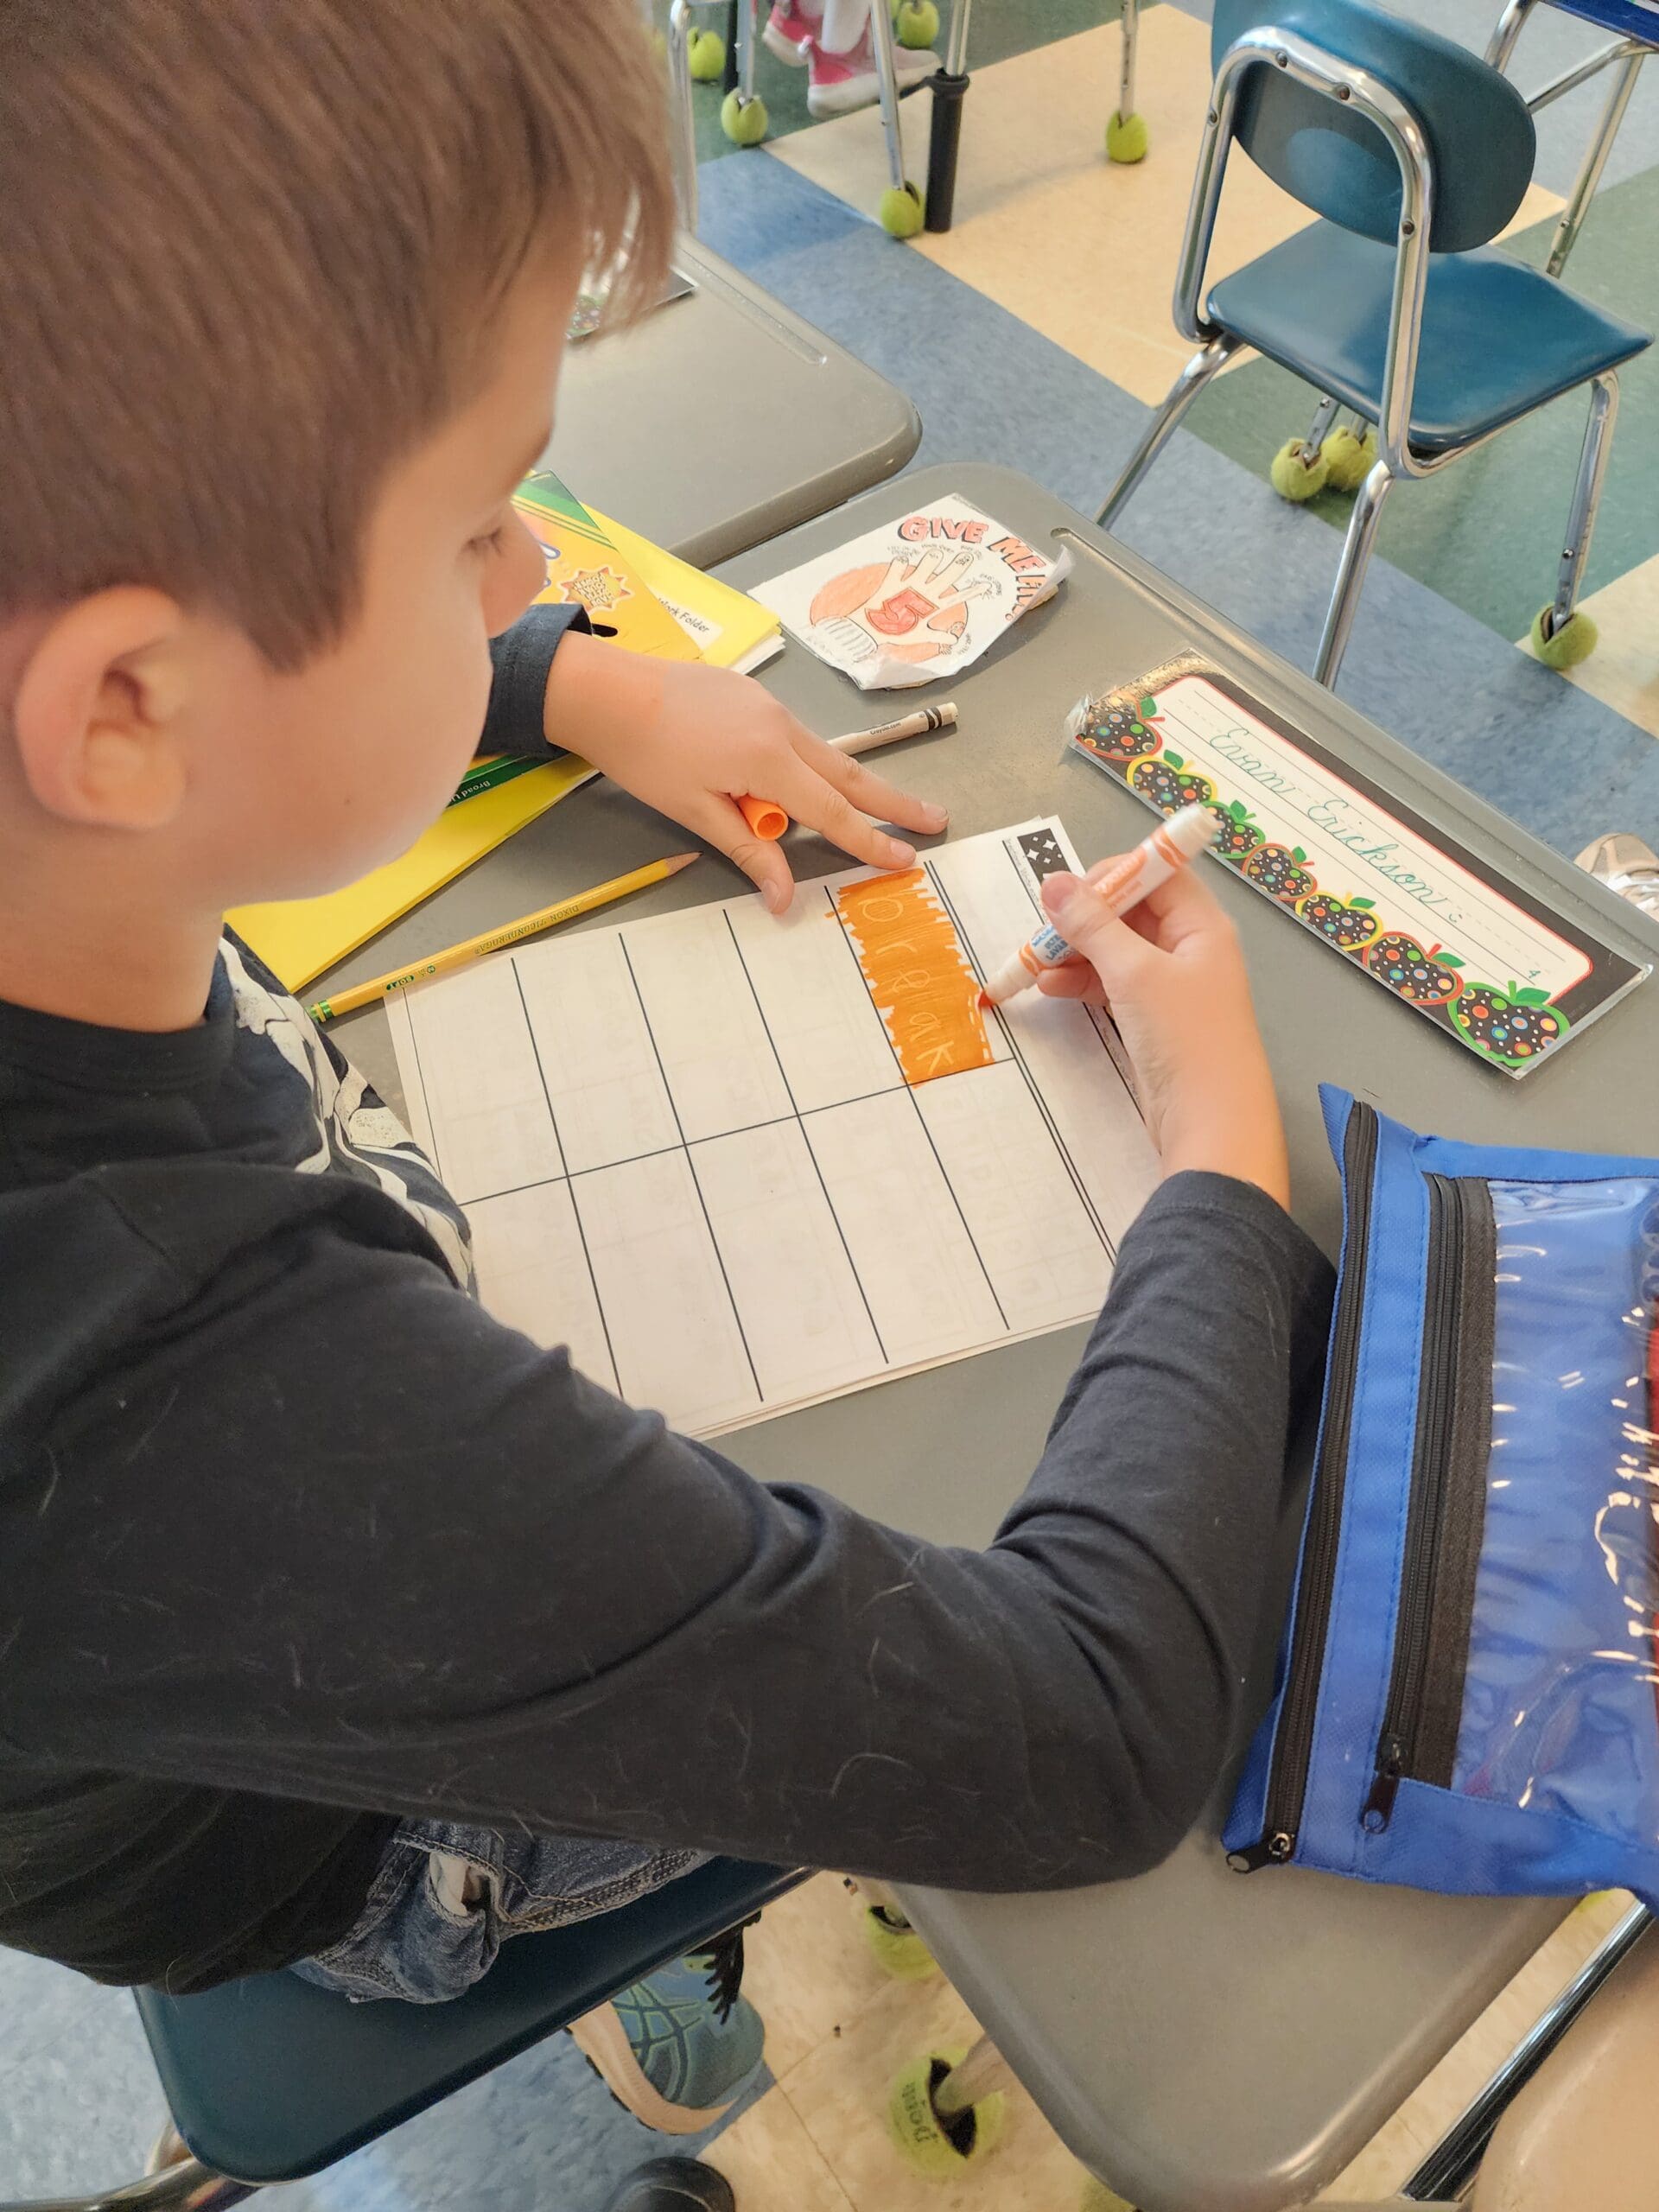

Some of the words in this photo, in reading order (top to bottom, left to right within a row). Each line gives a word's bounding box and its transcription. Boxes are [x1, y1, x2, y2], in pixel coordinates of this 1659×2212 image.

[898, 517, 988, 543] GIVE
[988, 537, 1046, 573] ME
[679, 612, 709, 632] Folder
[865, 587, 939, 635] 5
[461, 780, 491, 798] Broad
[1210, 728, 1296, 793] Evan
[1307, 799, 1448, 904] Erickson
[550, 904, 580, 923] DIXON
[478, 918, 547, 951] TICONDEROGA
